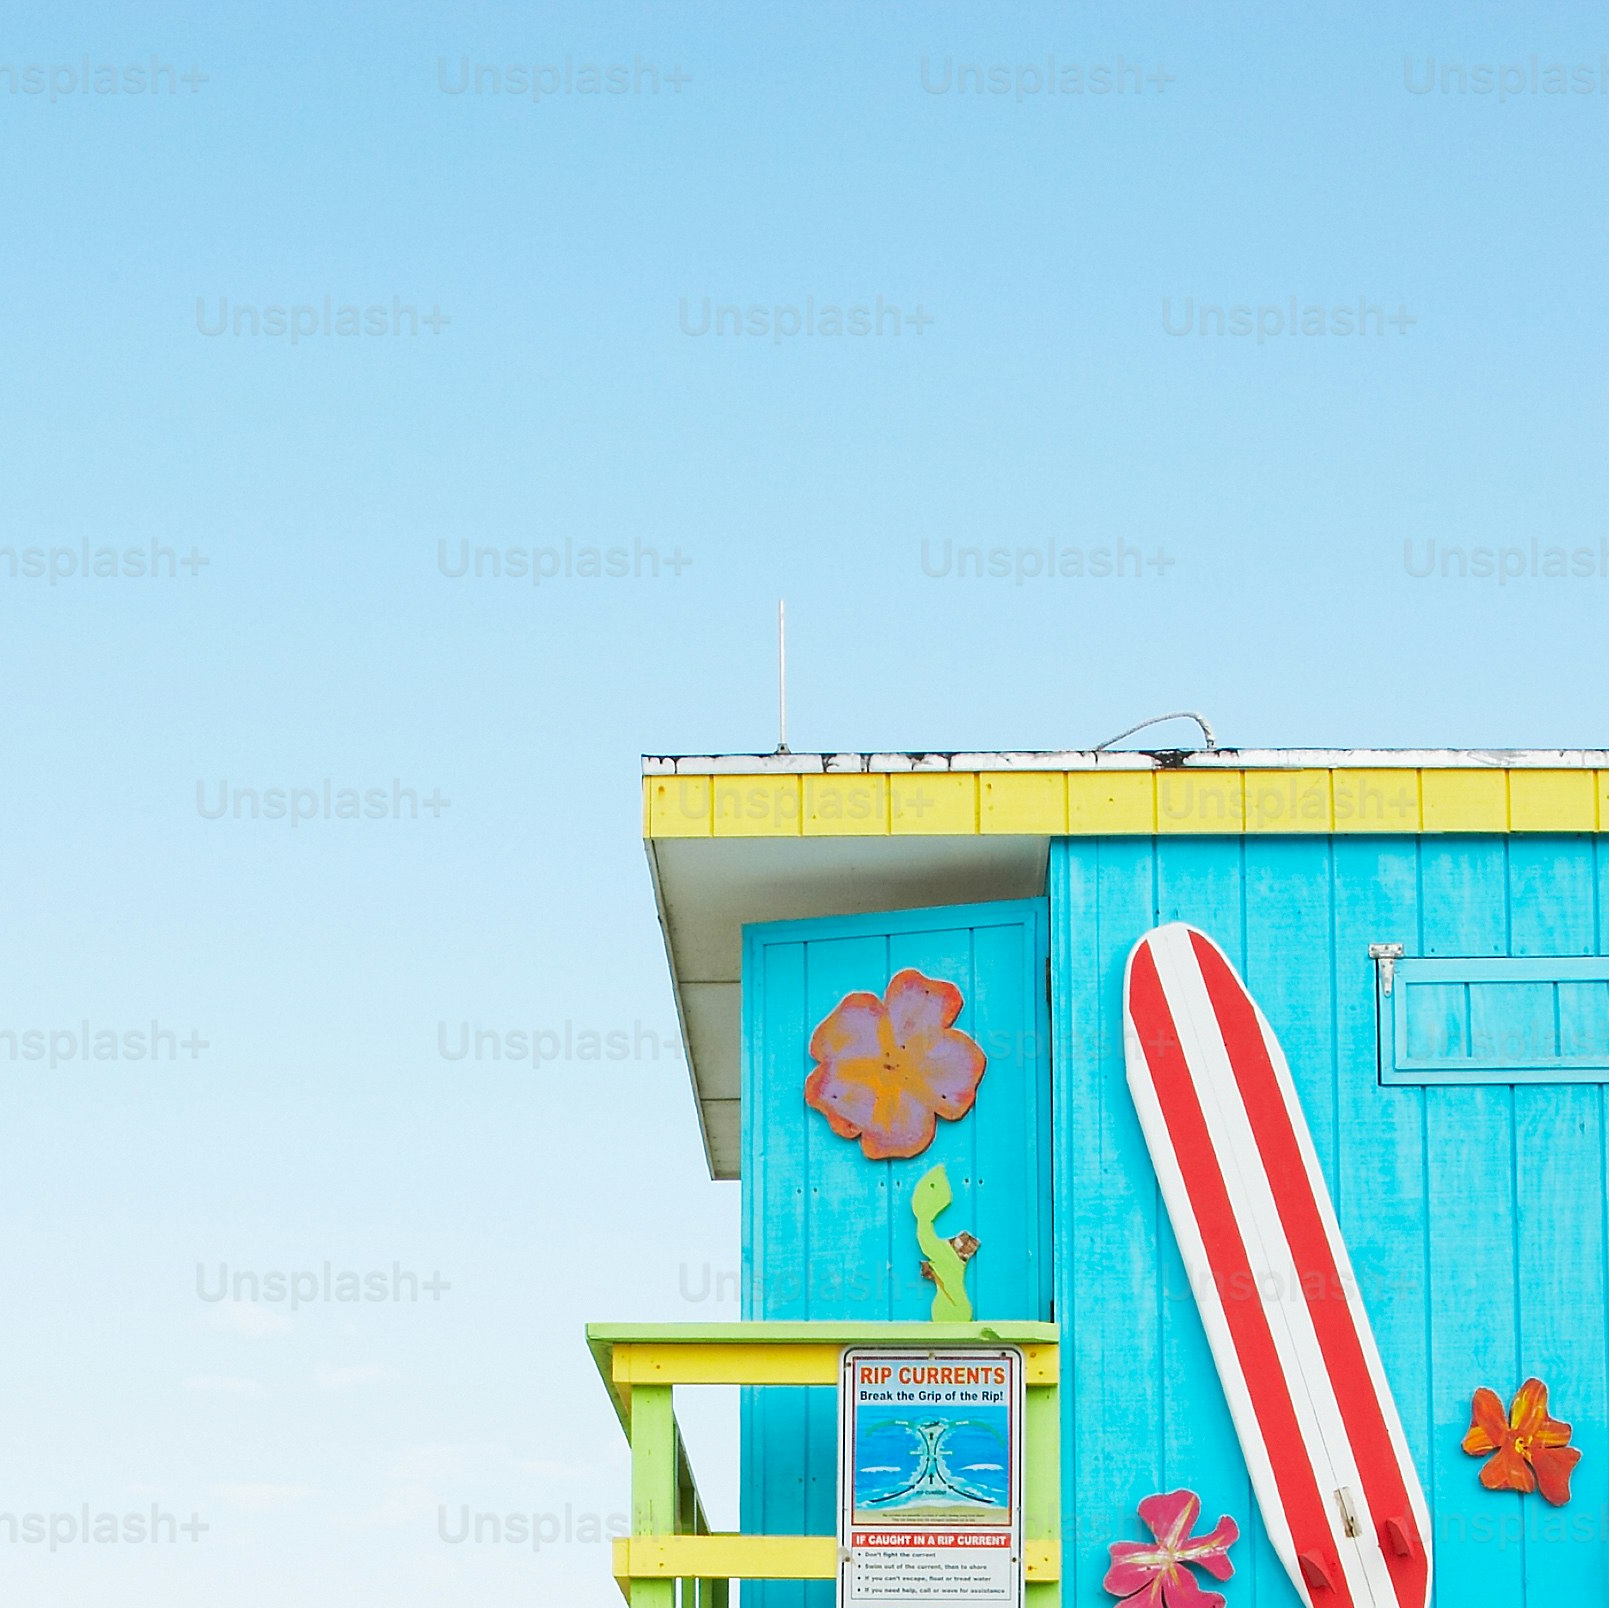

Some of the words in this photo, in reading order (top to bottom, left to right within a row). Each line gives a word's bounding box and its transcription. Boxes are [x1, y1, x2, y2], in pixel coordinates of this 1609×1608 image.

[860, 1367, 892, 1384] RIP
[898, 1367, 1006, 1385] CURRENTS
[860, 1390, 893, 1401] Break
[897, 1390, 915, 1401] the
[918, 1390, 942, 1403] Grip
[945, 1391, 956, 1401] of
[960, 1391, 978, 1401] the
[982, 1391, 1003, 1403] Rip!
[856, 1535, 866, 1545] IF
[868, 1535, 912, 1545] CAUGHT
[913, 1535, 925, 1545] IN
[927, 1535, 936, 1545] A
[937, 1535, 955, 1545] RIP
[957, 1535, 1007, 1545] CURRENT
[882, 1551, 898, 1559] fight
